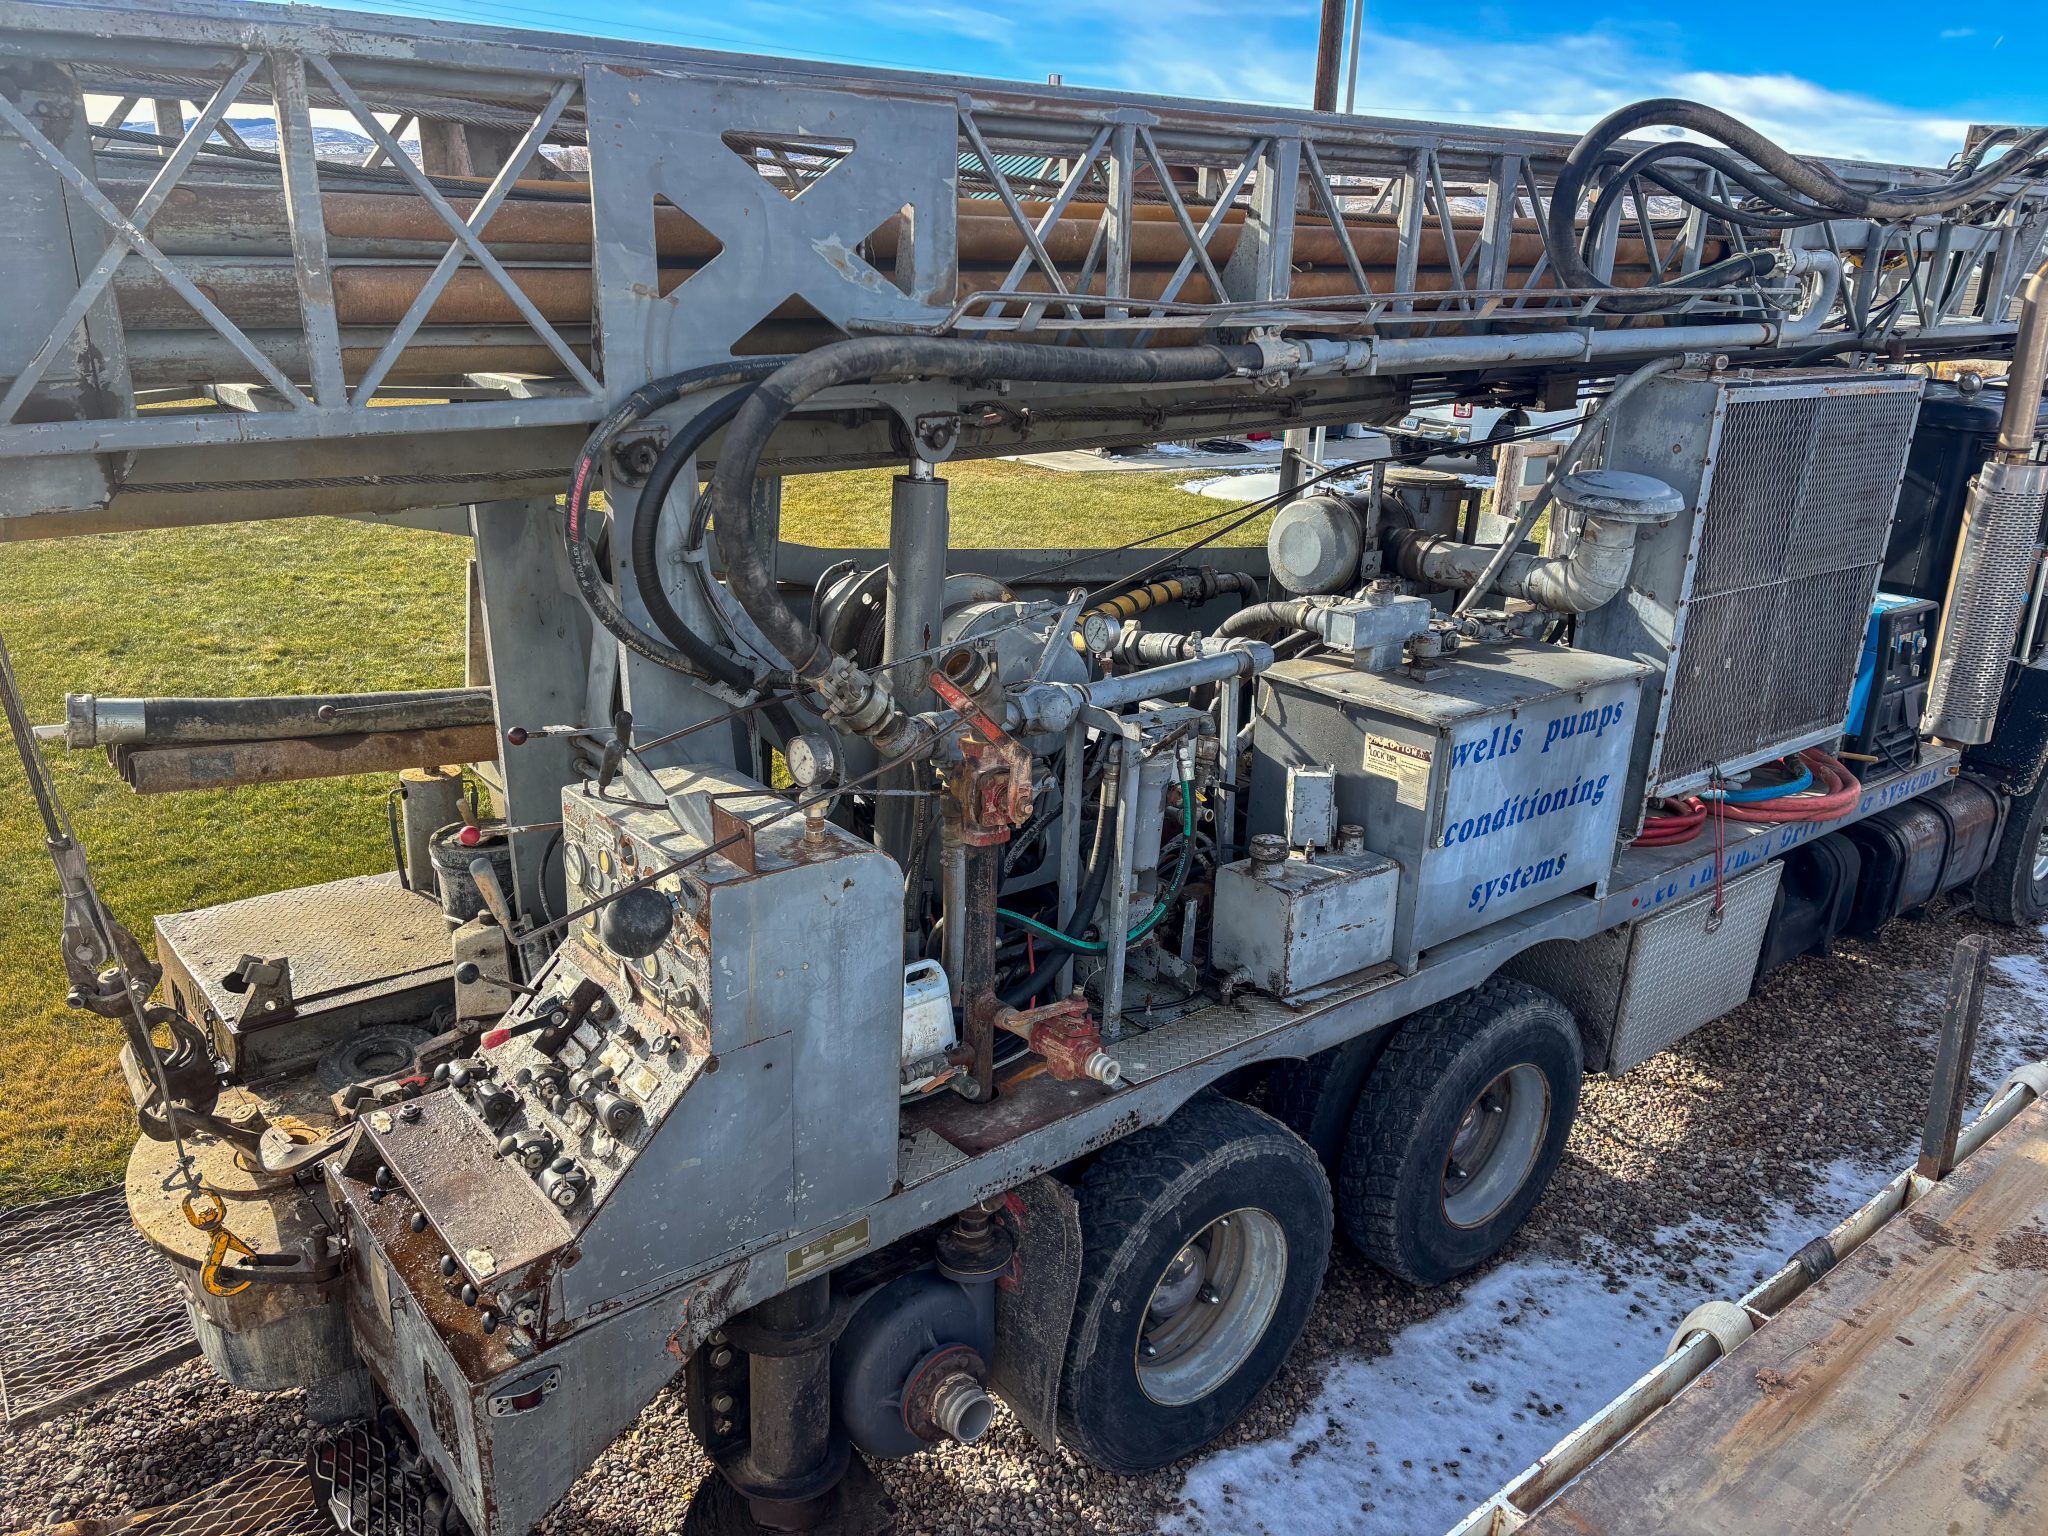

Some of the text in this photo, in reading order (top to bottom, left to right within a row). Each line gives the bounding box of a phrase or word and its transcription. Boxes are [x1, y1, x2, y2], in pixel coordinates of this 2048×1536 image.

[1370, 749, 1385, 760] LOCK
[1451, 701, 1624, 770] wells pumps
[1443, 774, 1610, 847] conditioning
[1468, 852, 1567, 913] systems
